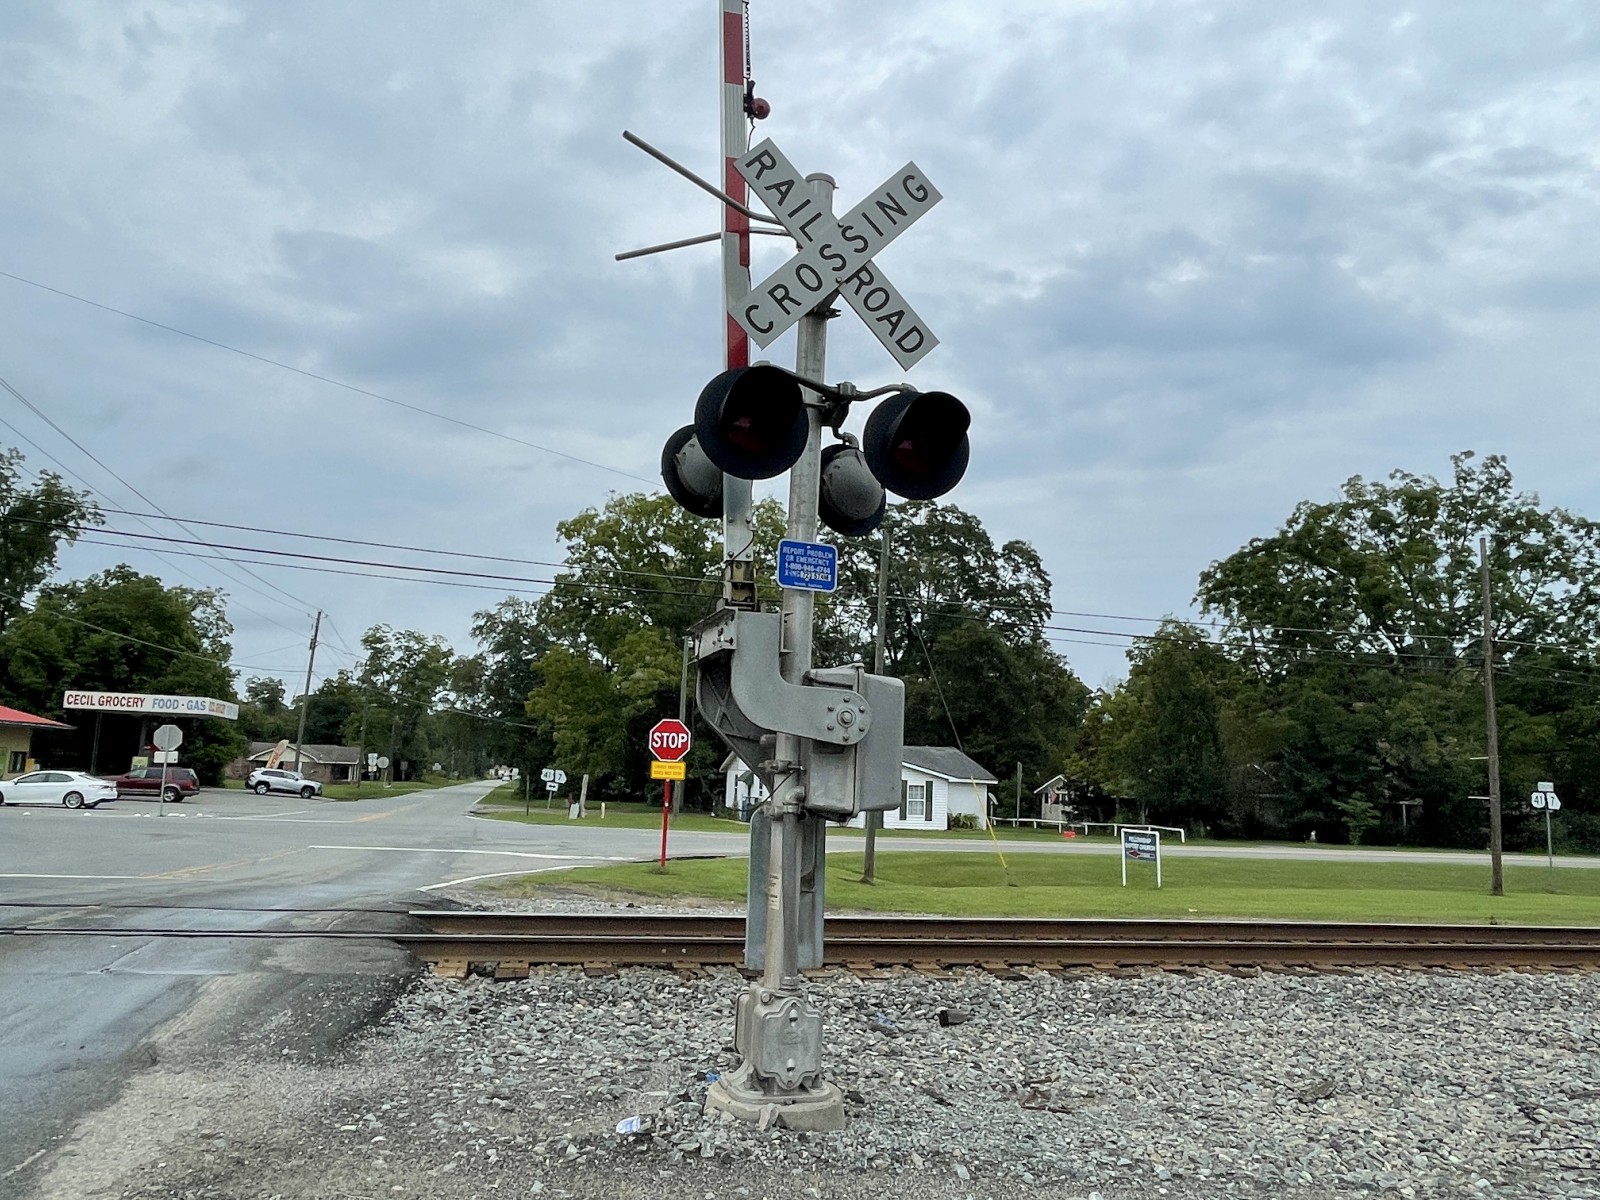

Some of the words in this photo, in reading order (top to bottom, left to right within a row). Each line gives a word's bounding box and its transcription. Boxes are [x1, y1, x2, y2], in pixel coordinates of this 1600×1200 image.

[744, 149, 822, 242] RAIL
[845, 263, 925, 354] ROAD
[744, 174, 929, 335] CROSSING
[782, 546, 804, 556] REPORT
[807, 549, 833, 559] PROBLEM
[785, 554, 794, 562] OR
[796, 556, 830, 566] EMERGENCY
[66, 694, 95, 706] CECIL
[98, 695, 146, 708] GROCERY
[152, 698, 179, 710] FOOD
[186, 699, 207, 711] GAS
[652, 732, 688, 749] STOP
[543, 771, 552, 779] 41
[1533, 795, 1543, 806] 41
[1550, 796, 1555, 807] 7
